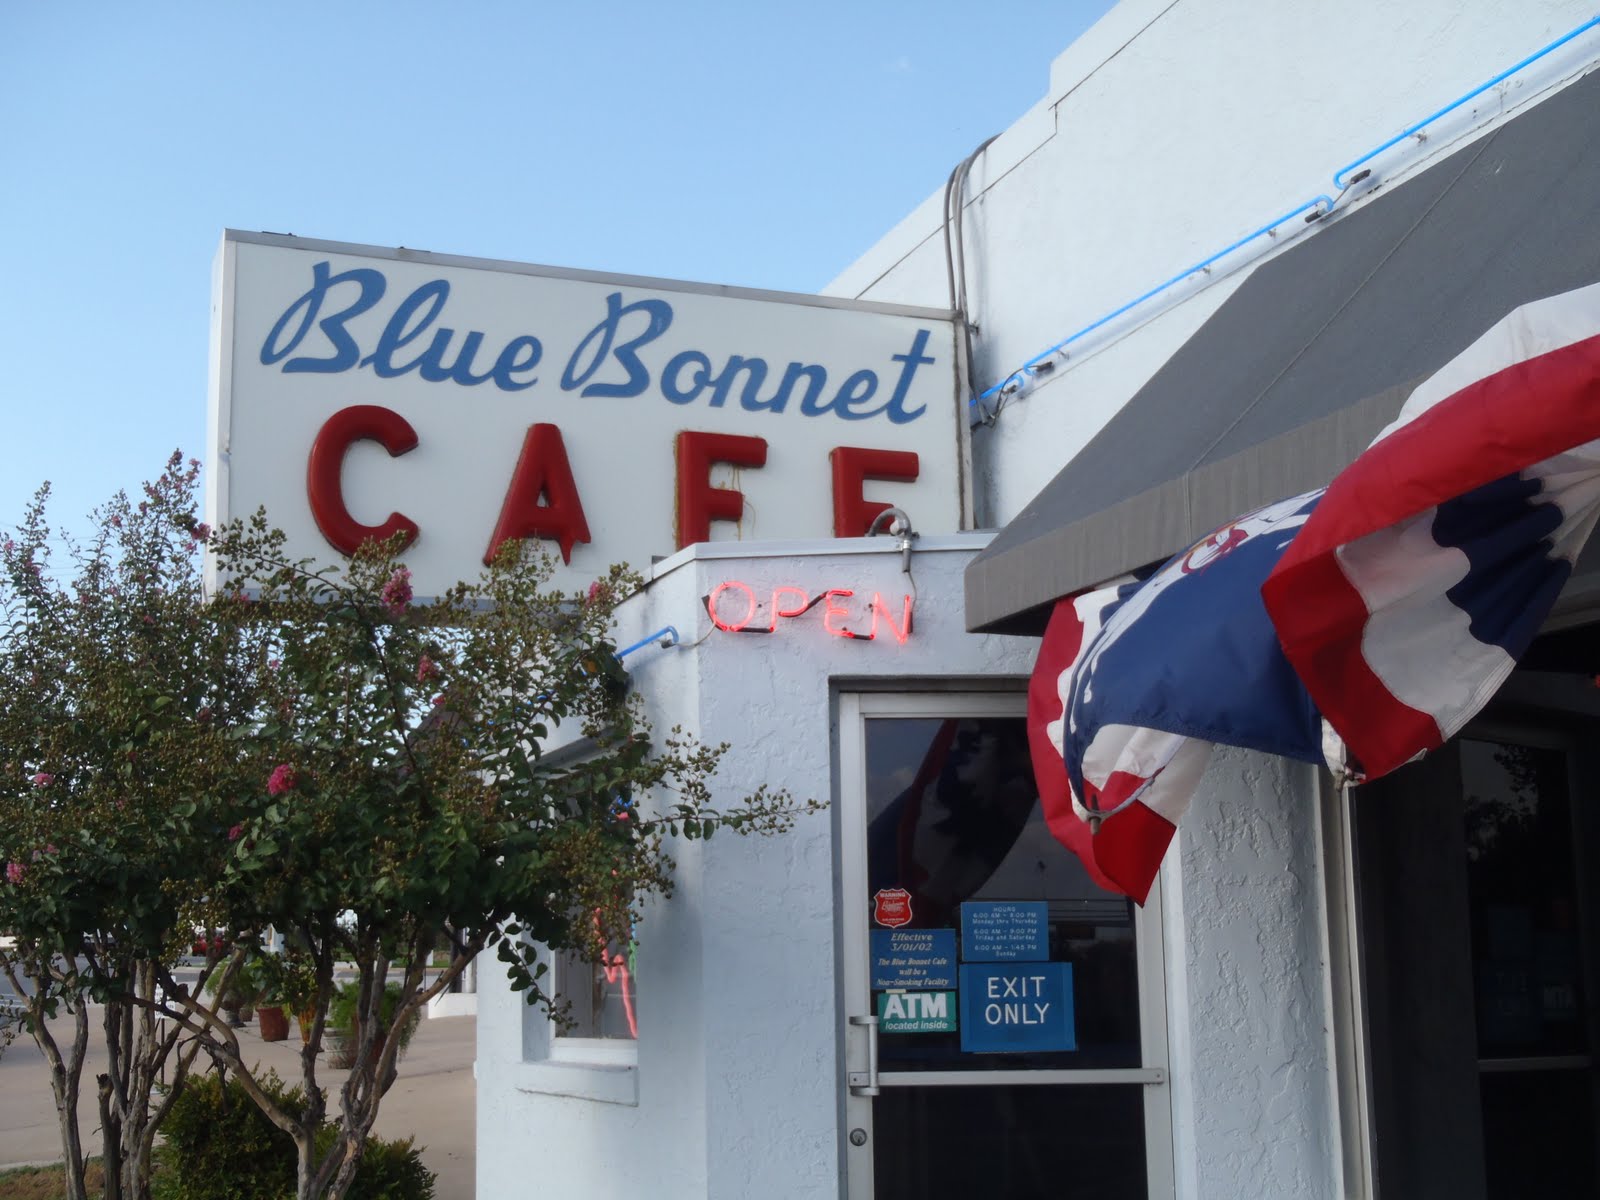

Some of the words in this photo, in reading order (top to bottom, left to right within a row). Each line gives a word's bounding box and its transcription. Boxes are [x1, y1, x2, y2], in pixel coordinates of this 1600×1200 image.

[259, 261, 544, 391] Blue
[560, 291, 935, 424] Bonnet
[307, 404, 920, 566] CAFE
[708, 579, 911, 644] OPEN
[890, 932, 933, 941] Effective
[878, 958, 889, 966] The
[891, 958, 906, 966] Blue
[908, 958, 931, 966] Bonnet
[932, 957, 947, 965] Cafe
[876, 978, 923, 987] Non-Smoking
[923, 978, 950, 986] Facility
[987, 976, 1046, 998] EXIT
[883, 993, 947, 1019] ATM
[985, 1002, 1050, 1025] ONLY
[885, 1021, 919, 1031] located
[920, 1020, 948, 1030] inside
